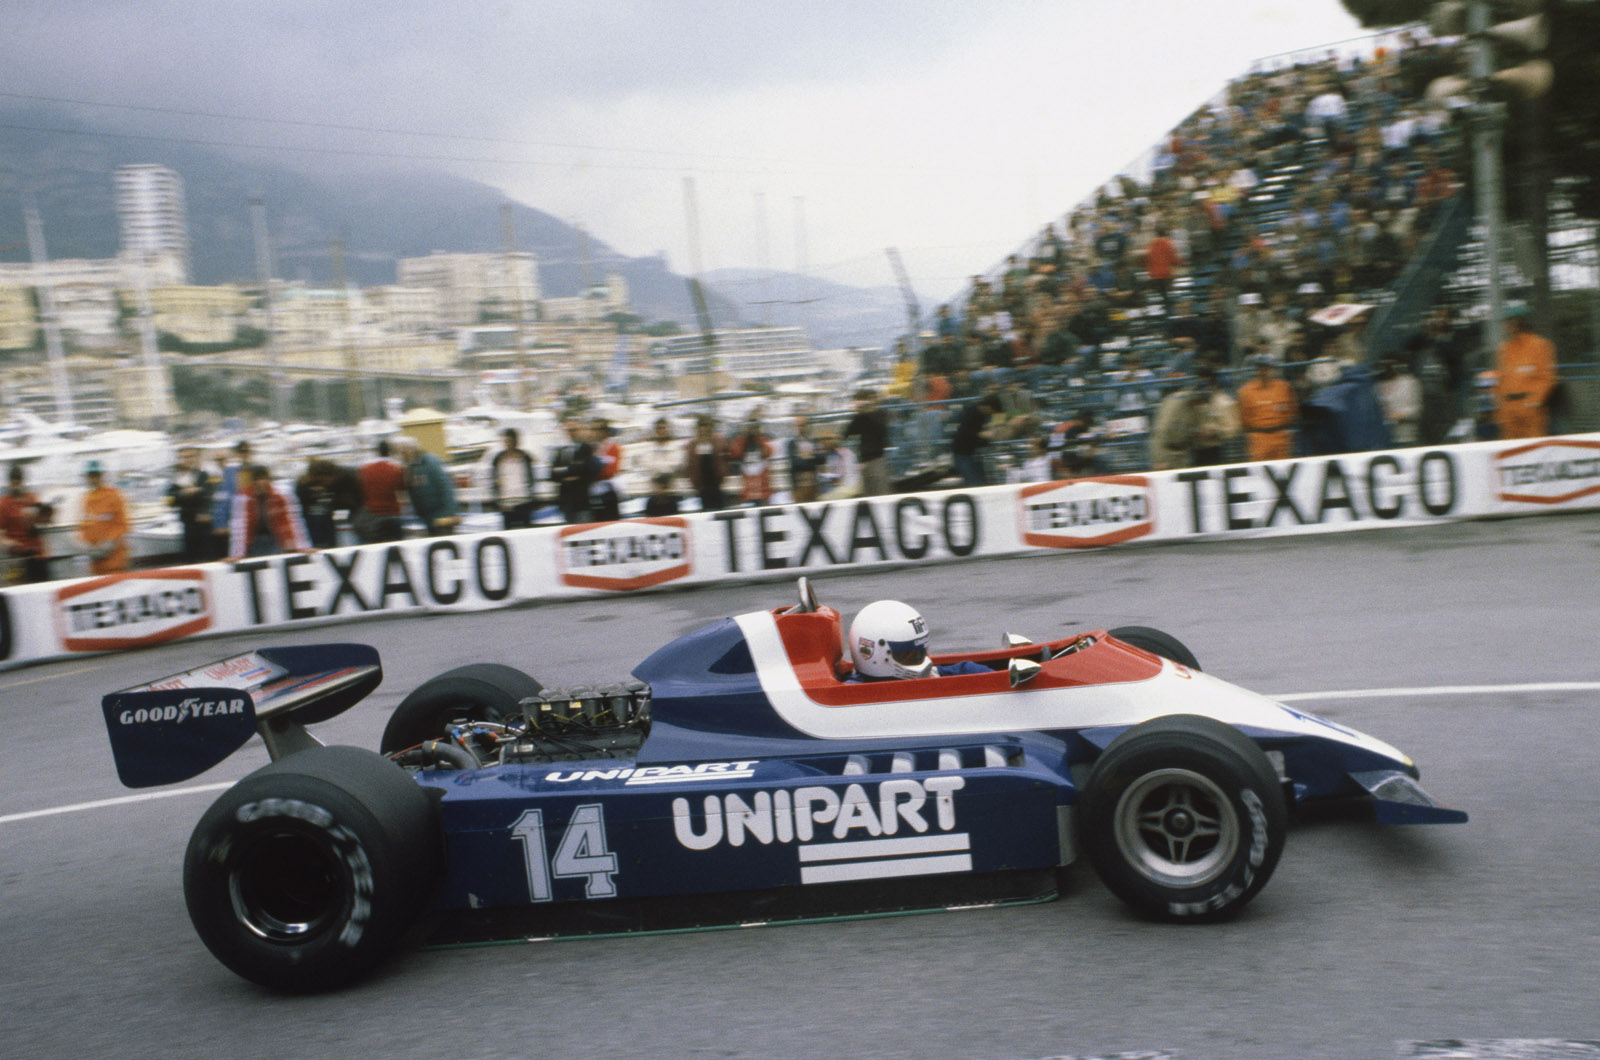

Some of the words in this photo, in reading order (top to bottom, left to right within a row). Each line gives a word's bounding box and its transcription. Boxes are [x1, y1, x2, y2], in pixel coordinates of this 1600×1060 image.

[1028, 493, 1148, 530] TEXACO
[1177, 451, 1456, 534] TEXACO
[567, 530, 684, 568] TEXACO
[714, 494, 977, 573] TEXACO
[65, 587, 206, 633] TEXACO
[233, 536, 512, 626] TEXACO
[119, 697, 246, 725] GOODYEAR
[545, 760, 760, 784] UNIPART
[672, 775, 966, 851] UNIPART
[507, 802, 620, 904] 14
